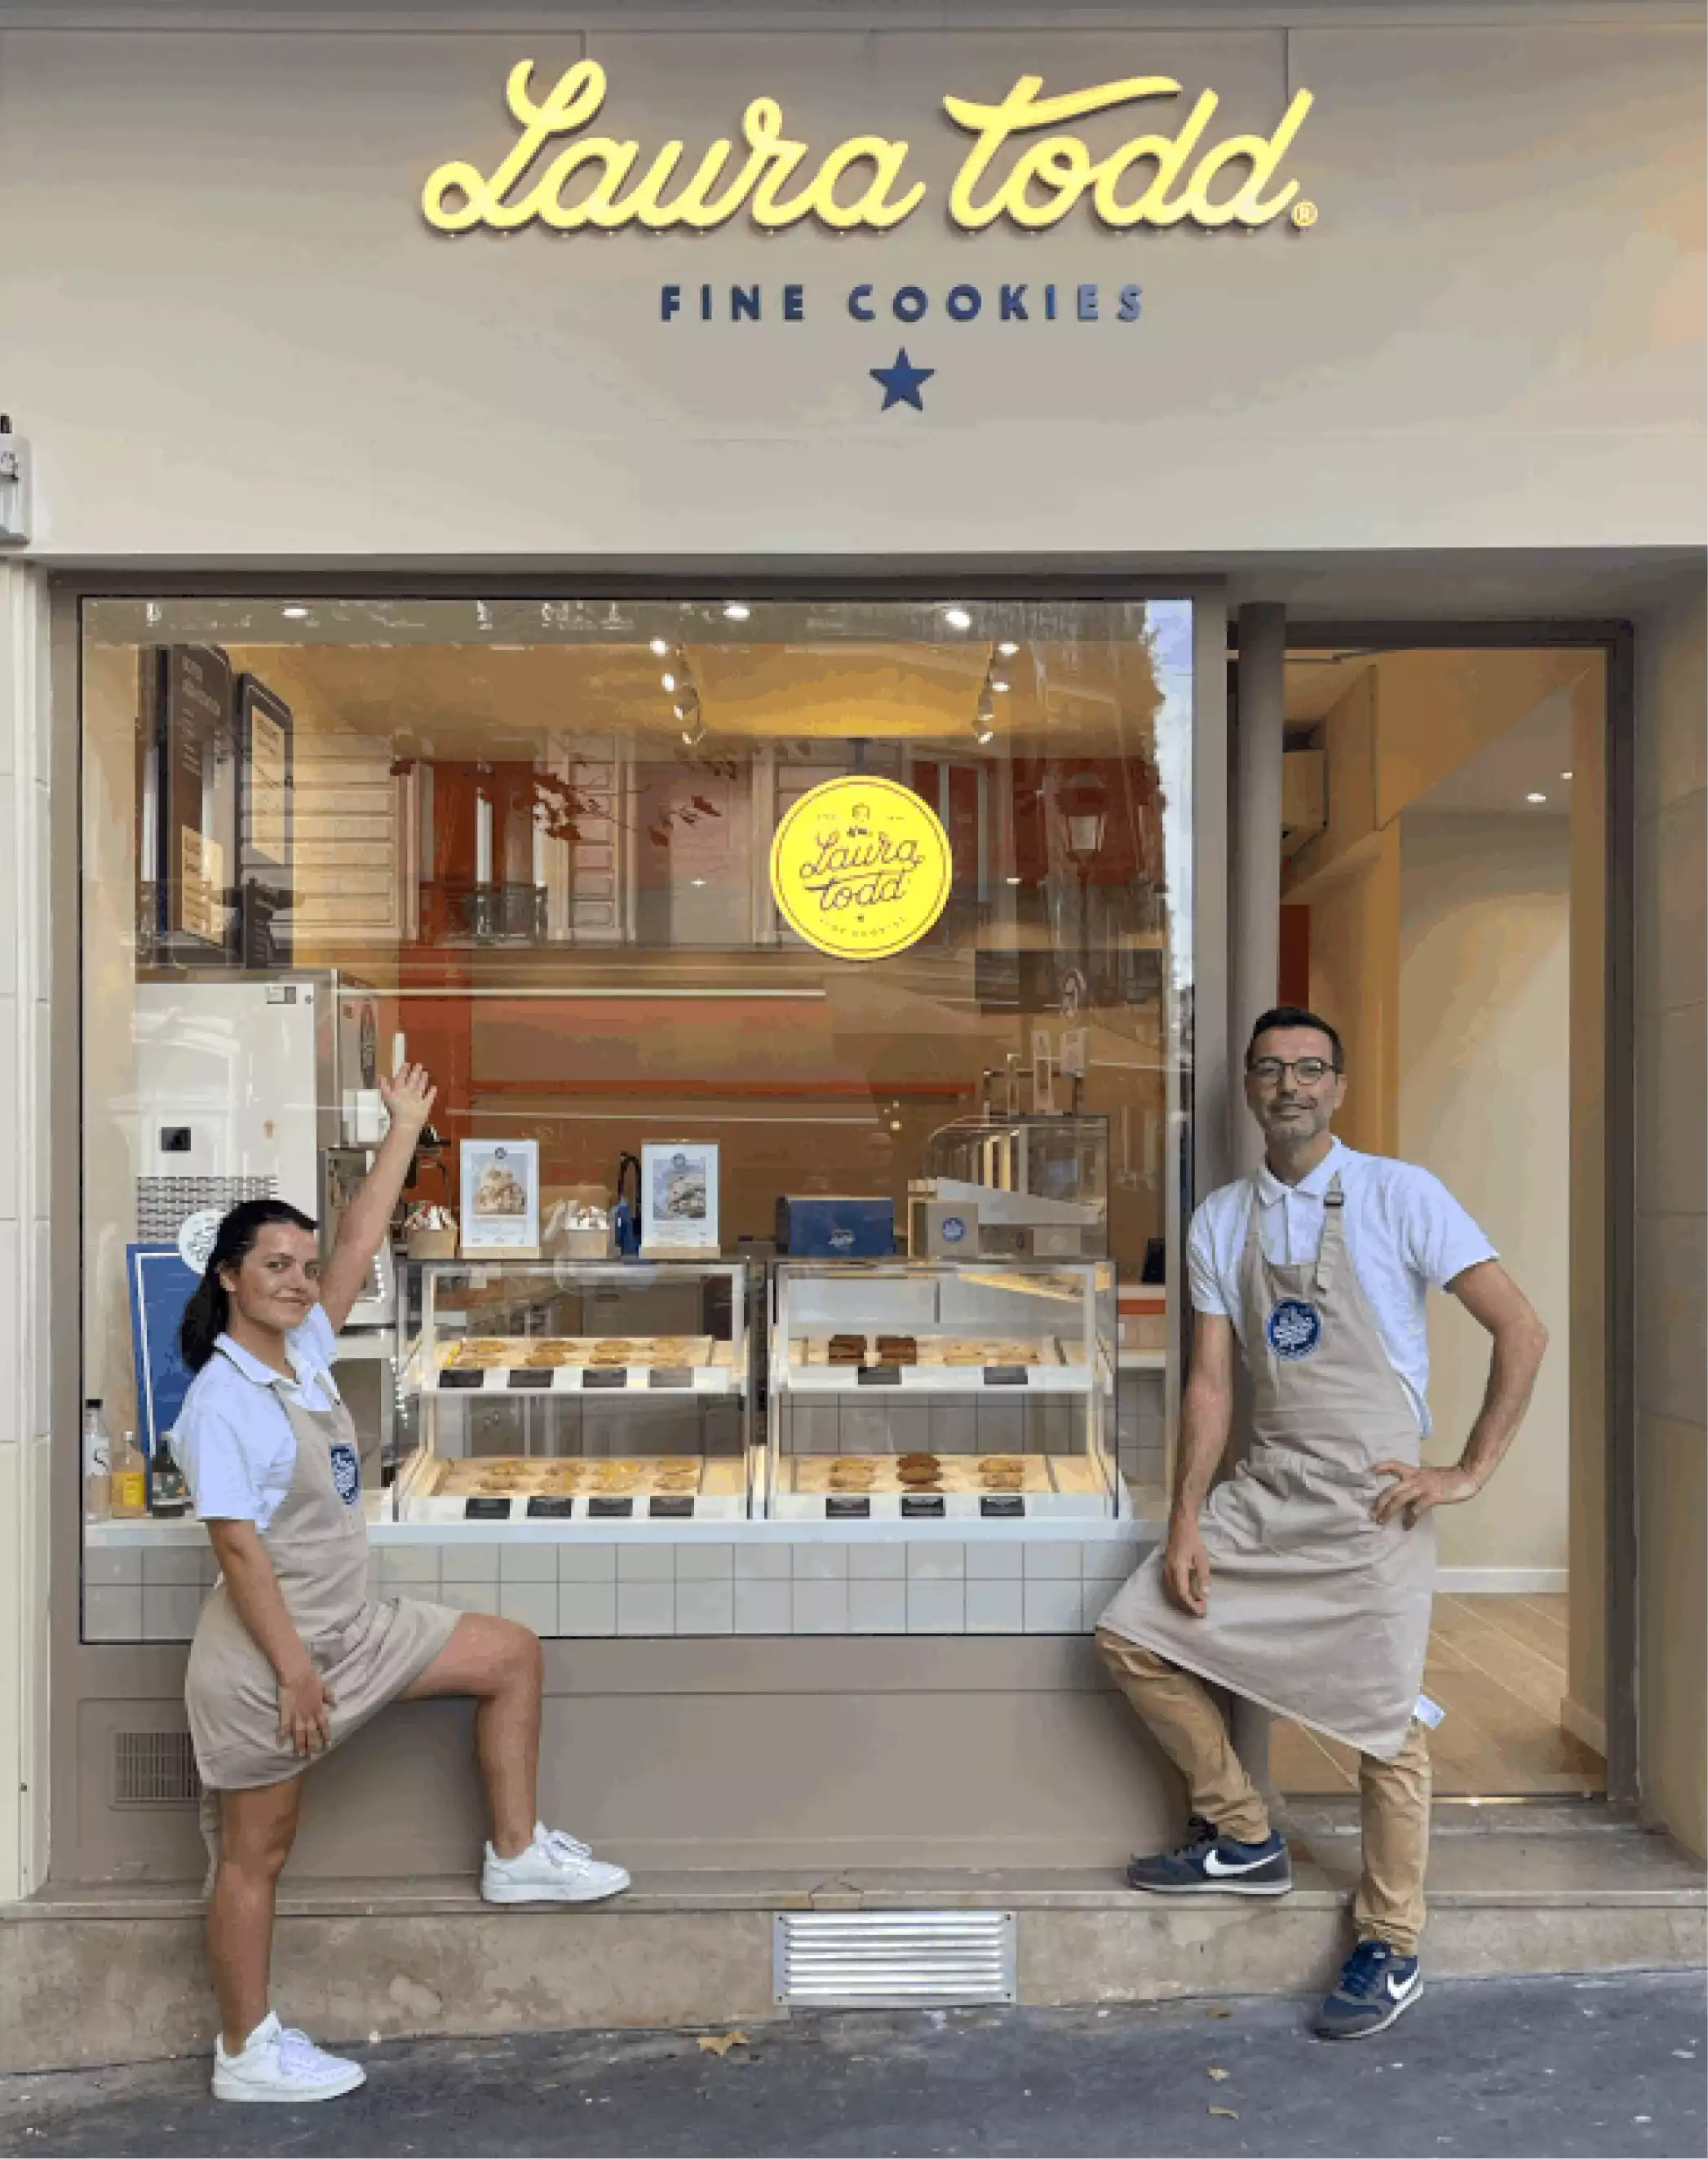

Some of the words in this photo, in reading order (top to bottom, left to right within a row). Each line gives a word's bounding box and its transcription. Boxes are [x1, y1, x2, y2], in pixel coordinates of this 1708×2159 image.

[421, 59, 927, 232] Laura
[660, 284, 805, 322] FINE
[847, 284, 1144, 322] COOKIES
[799, 827, 927, 879] Laura
